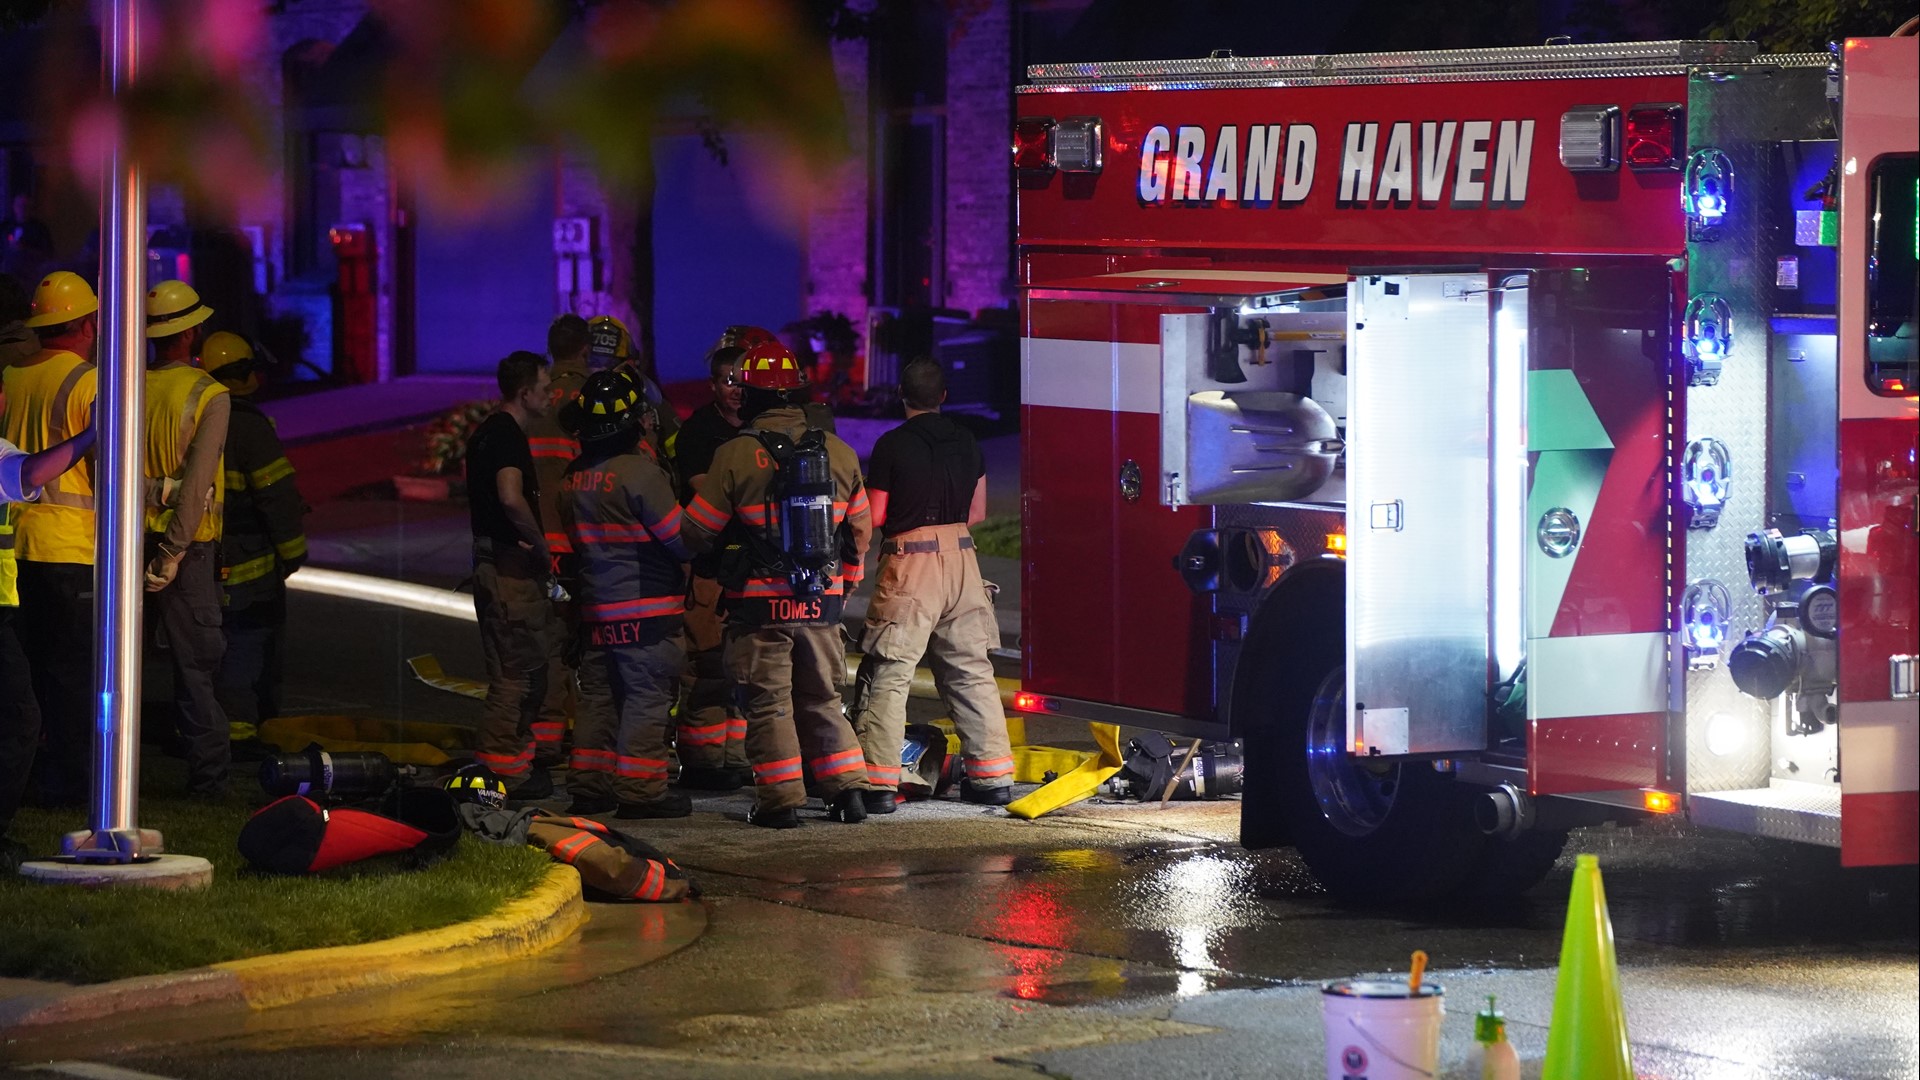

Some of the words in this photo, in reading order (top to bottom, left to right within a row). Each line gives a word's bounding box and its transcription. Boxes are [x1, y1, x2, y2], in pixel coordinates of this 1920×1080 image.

[1138, 124, 1318, 206] GRAND
[1337, 120, 1535, 206] HAVEN
[592, 333, 617, 347] 705
[768, 598, 822, 620] TOMES
